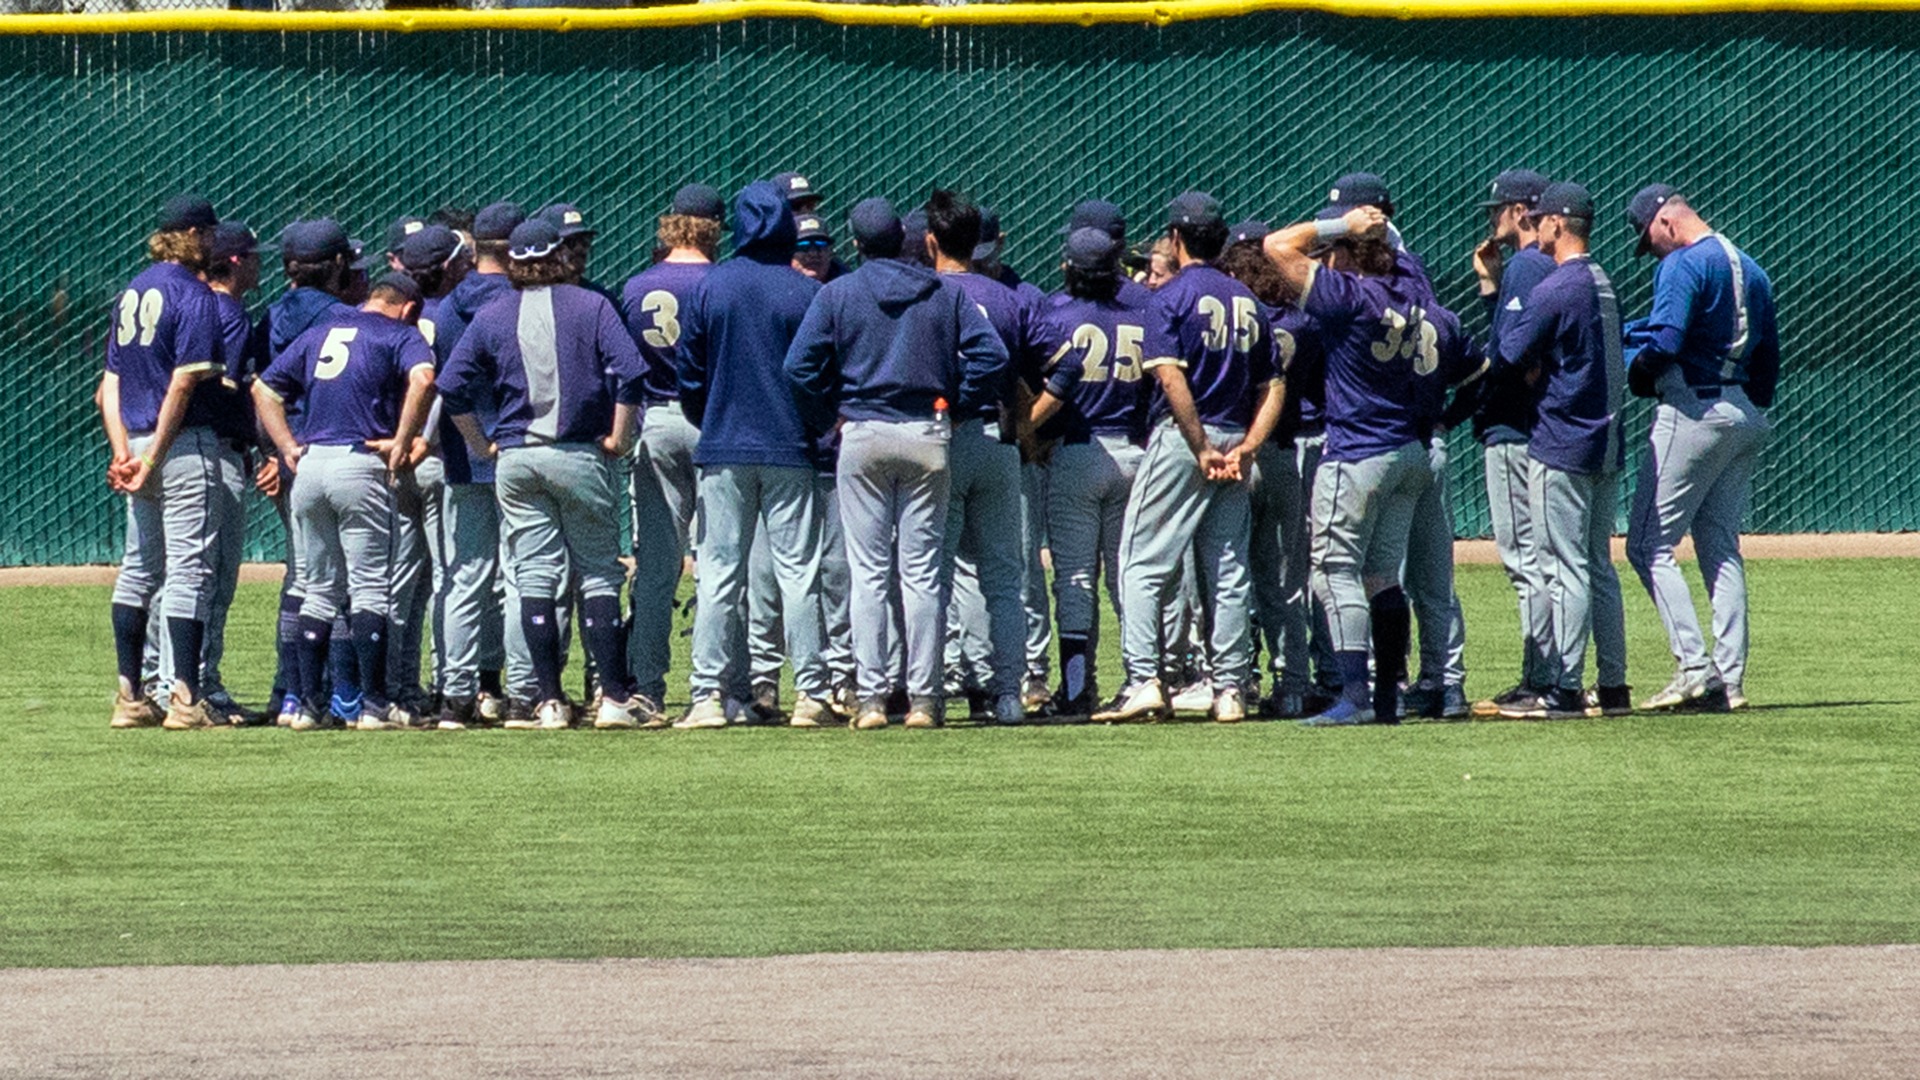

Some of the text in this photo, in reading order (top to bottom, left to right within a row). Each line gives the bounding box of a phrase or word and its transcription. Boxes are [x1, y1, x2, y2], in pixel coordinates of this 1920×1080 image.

[118, 288, 163, 346] 39
[641, 290, 680, 347] 3
[1198, 295, 1259, 353] 35
[313, 327, 358, 379] 5
[1072, 323, 1144, 382] 25
